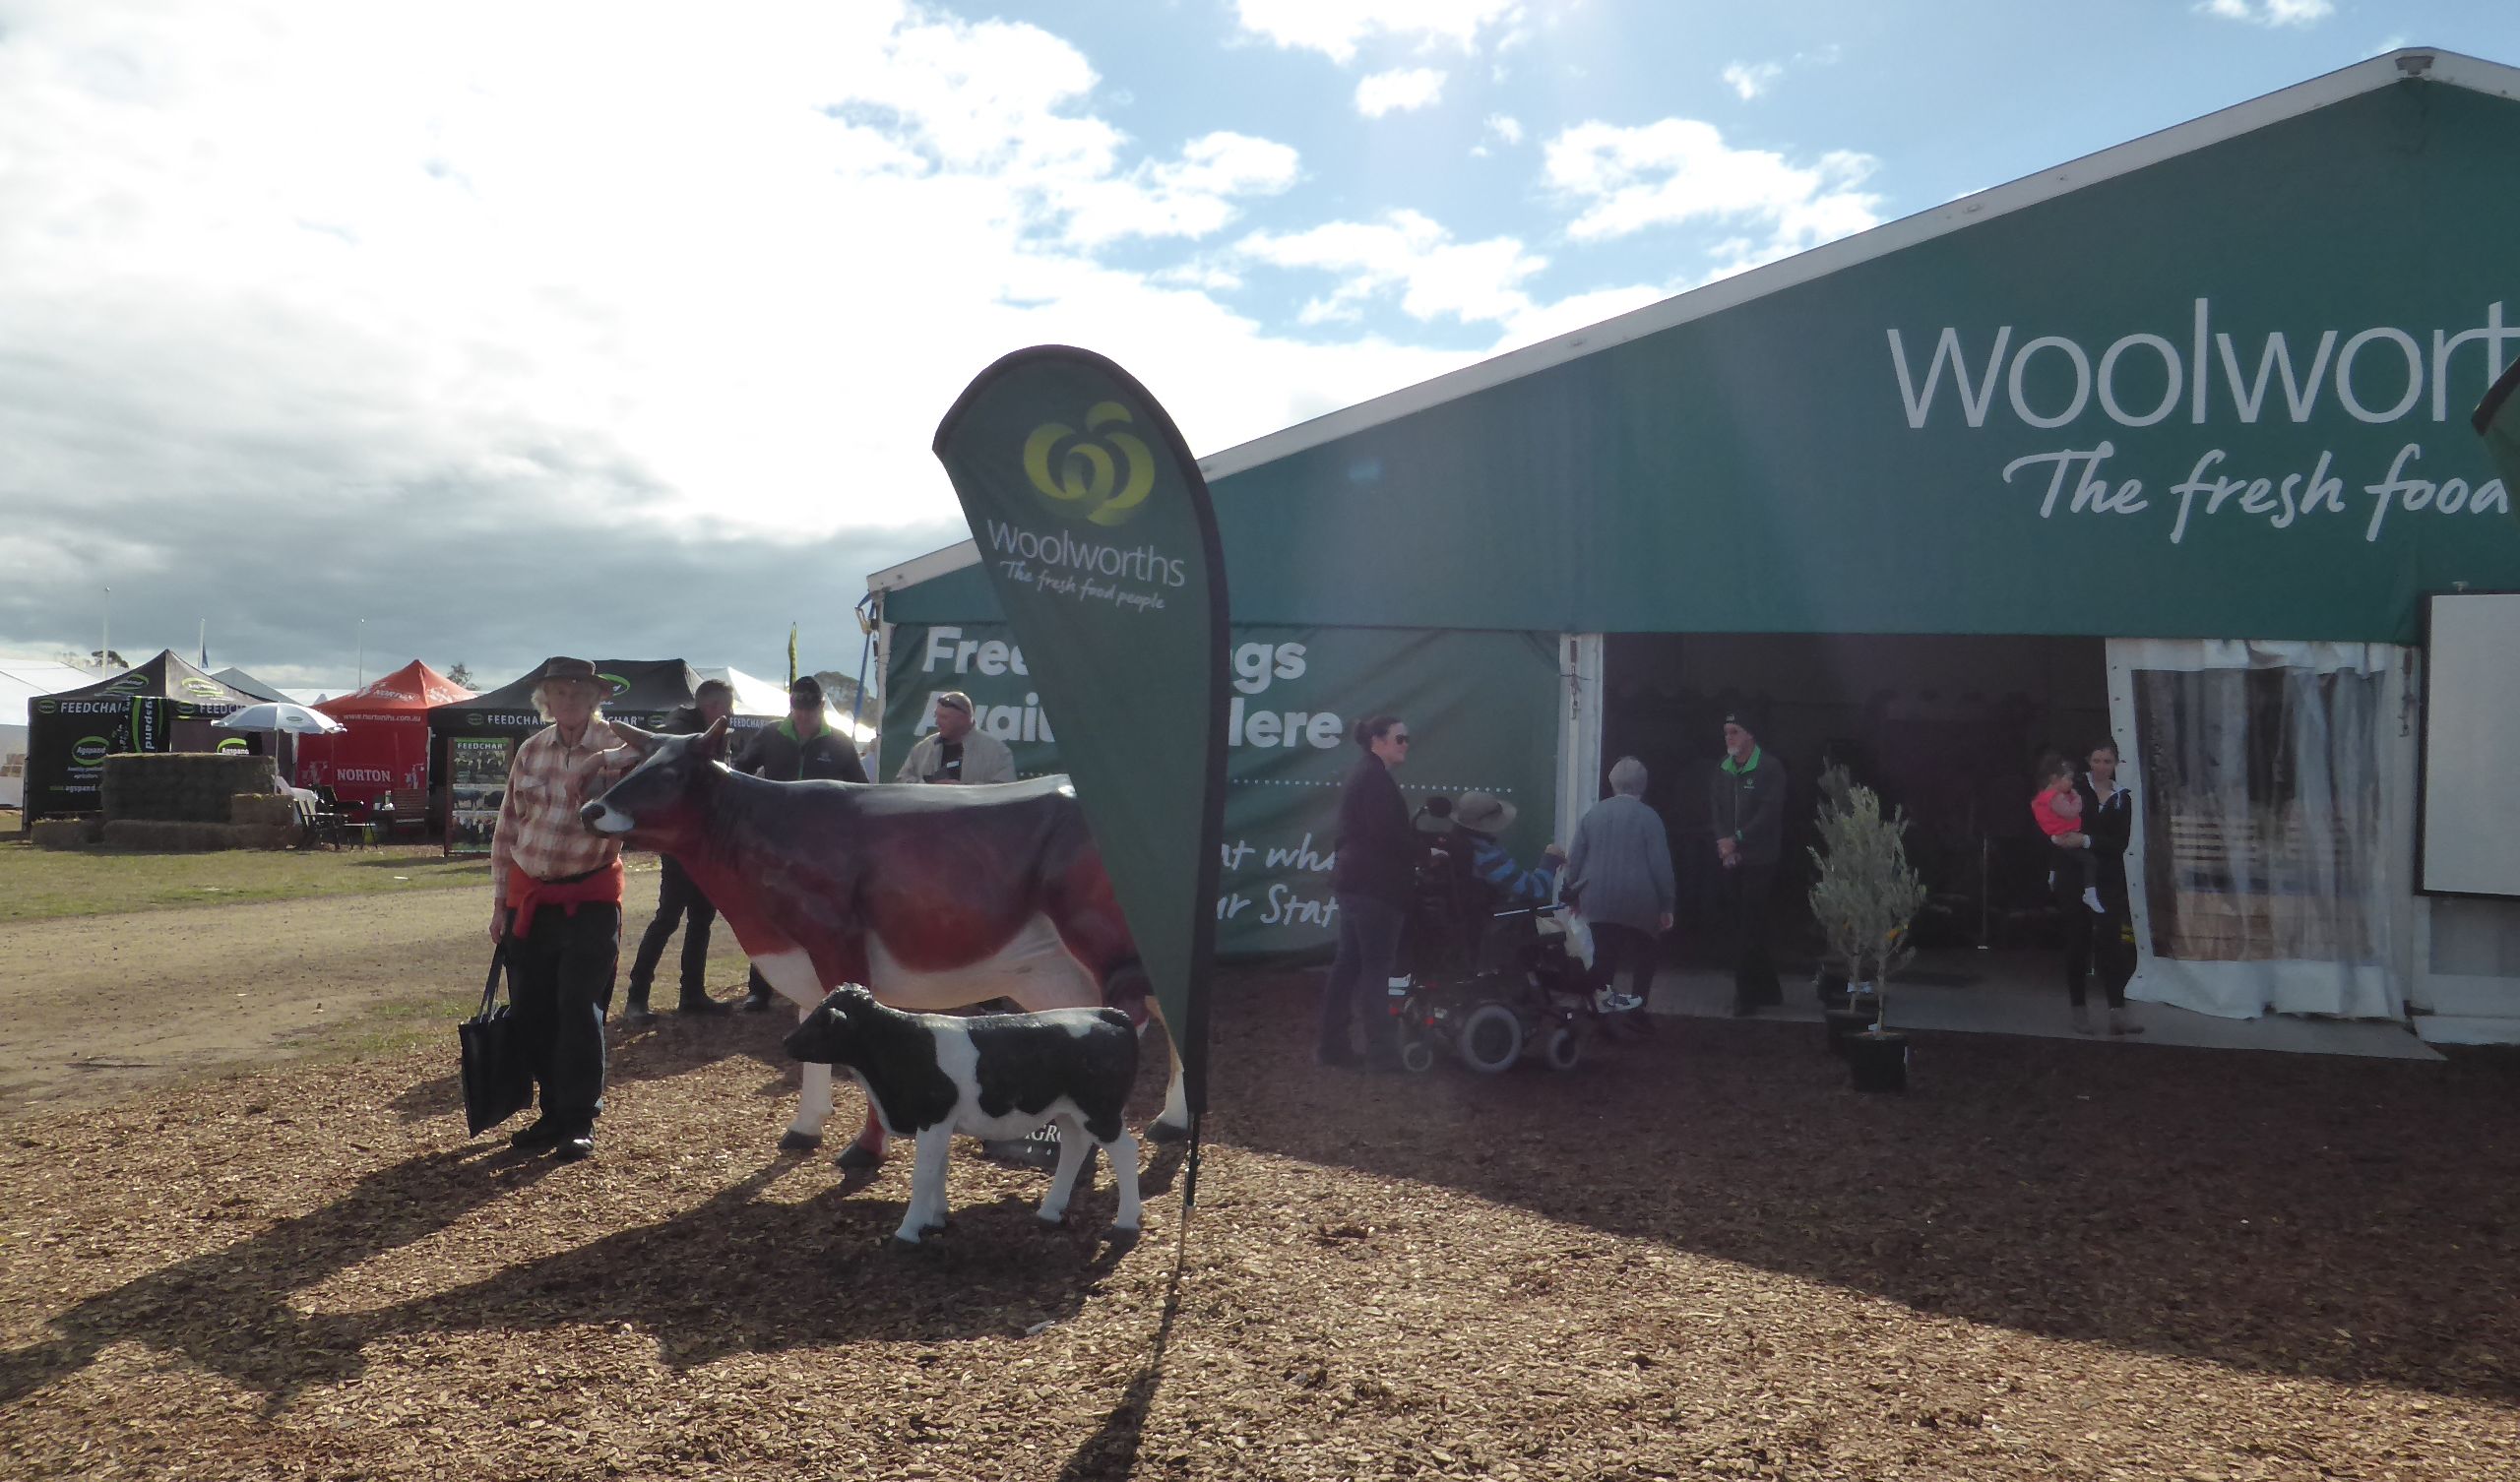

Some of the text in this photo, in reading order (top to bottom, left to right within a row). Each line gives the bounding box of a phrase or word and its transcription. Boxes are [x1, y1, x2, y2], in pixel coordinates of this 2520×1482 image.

[2002, 440, 2148, 519] The
[2170, 448, 2346, 544] fresh
[986, 519, 1185, 587] Woolworths
[999, 560, 1166, 613] The fresh food people
[337, 769, 392, 782] NORTON
